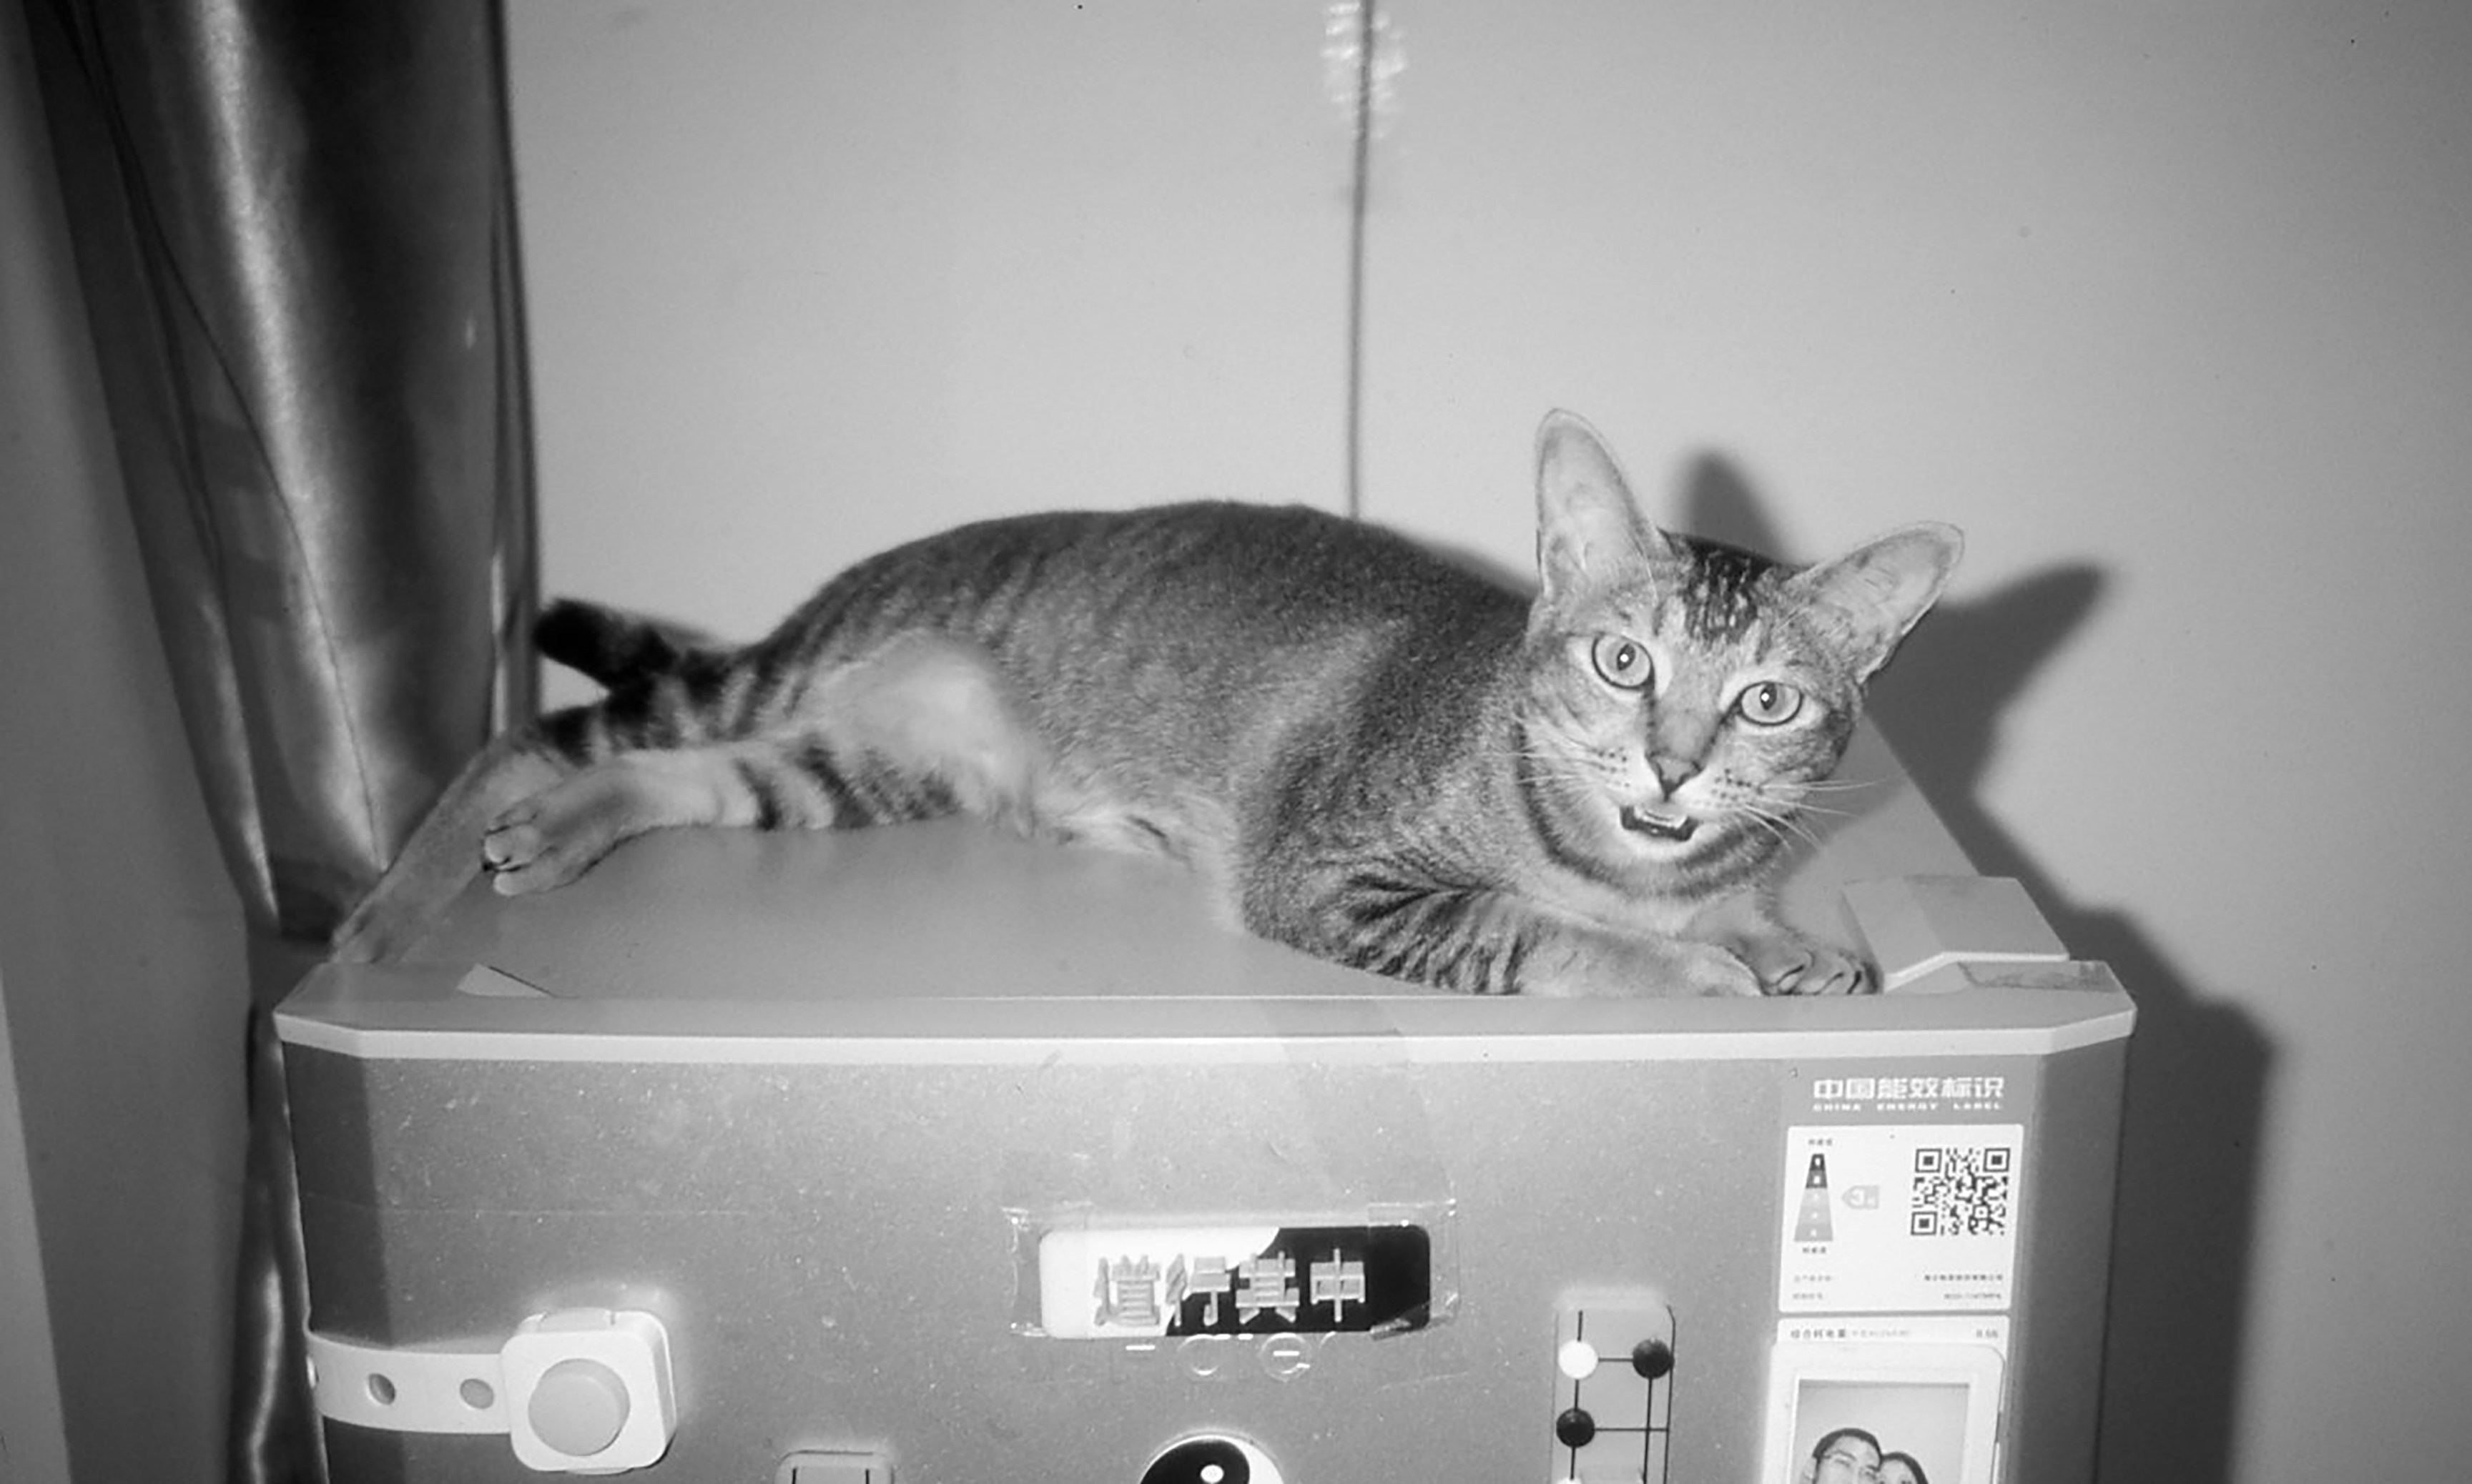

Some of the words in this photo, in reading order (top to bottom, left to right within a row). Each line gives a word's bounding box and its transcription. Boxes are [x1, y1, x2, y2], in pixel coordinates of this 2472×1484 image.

[1813, 1077, 2004, 1099] 中国能效标识
[1813, 1103, 1861, 1112] CHINA
[1877, 1102, 1939, 1111] ENERGY
[1953, 1102, 2001, 1110] LABEL
